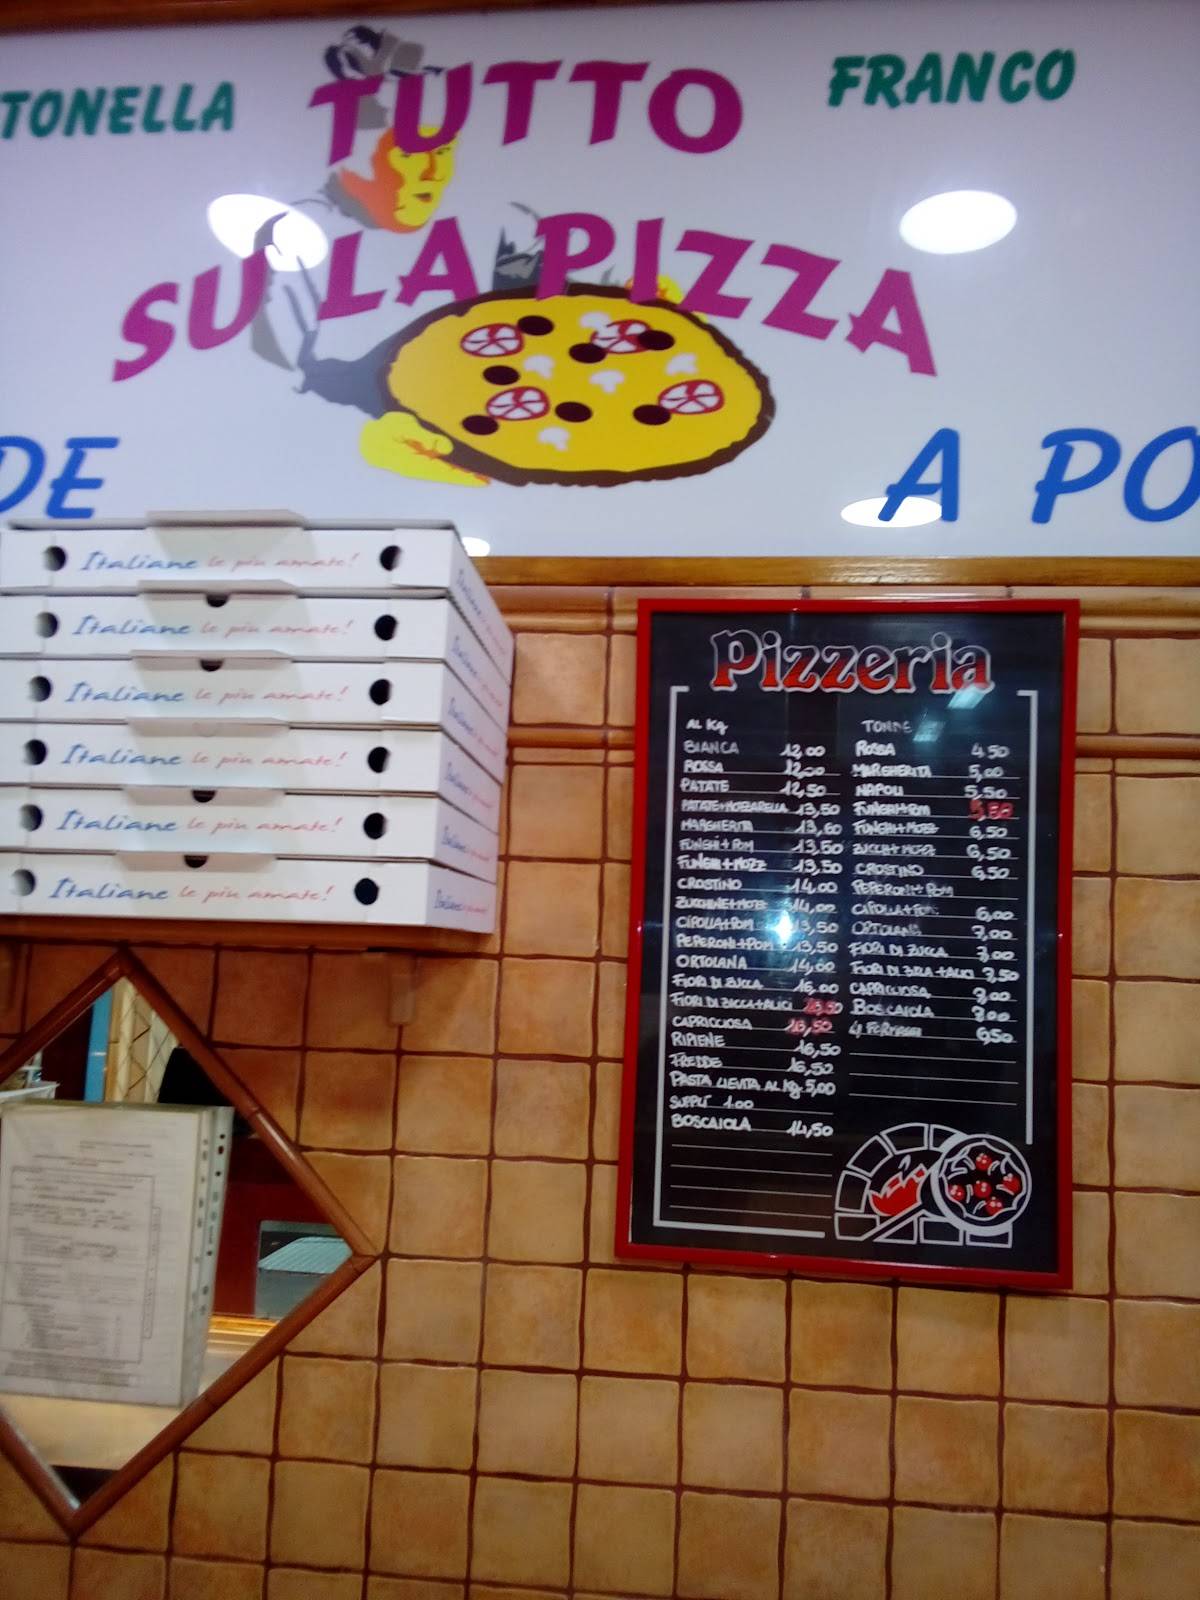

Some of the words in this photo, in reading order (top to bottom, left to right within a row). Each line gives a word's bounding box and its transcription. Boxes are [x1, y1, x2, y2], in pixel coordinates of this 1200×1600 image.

[827, 49, 1076, 109] FRANCO
[307, 62, 744, 167] TUTTO
[535, 212, 938, 378] PIZZA
[877, 427, 961, 522] A
[80, 551, 199, 571] Italiane
[72, 614, 191, 635] Italiane
[710, 629, 995, 694] Pizzeria
[64, 681, 186, 703] Italiane
[60, 744, 184, 766] Italiane
[683, 739, 740, 755] BIANCA
[683, 759, 725, 774] ROSSA
[680, 777, 730, 793] PATATE
[780, 780, 827, 798] 12,50
[855, 783, 905, 797] NAPOLI
[55, 810, 178, 832] Italiane
[49, 878, 170, 900] Italiane
[677, 877, 743, 891] CROSTINO
[675, 954, 748, 970] ORTOLANA
[671, 1031, 726, 1047] RIPIENE
[669, 1052, 723, 1068] FREDDE
[669, 1070, 713, 1088] PASTA
[671, 1113, 752, 1131] BOSCAIOLA
